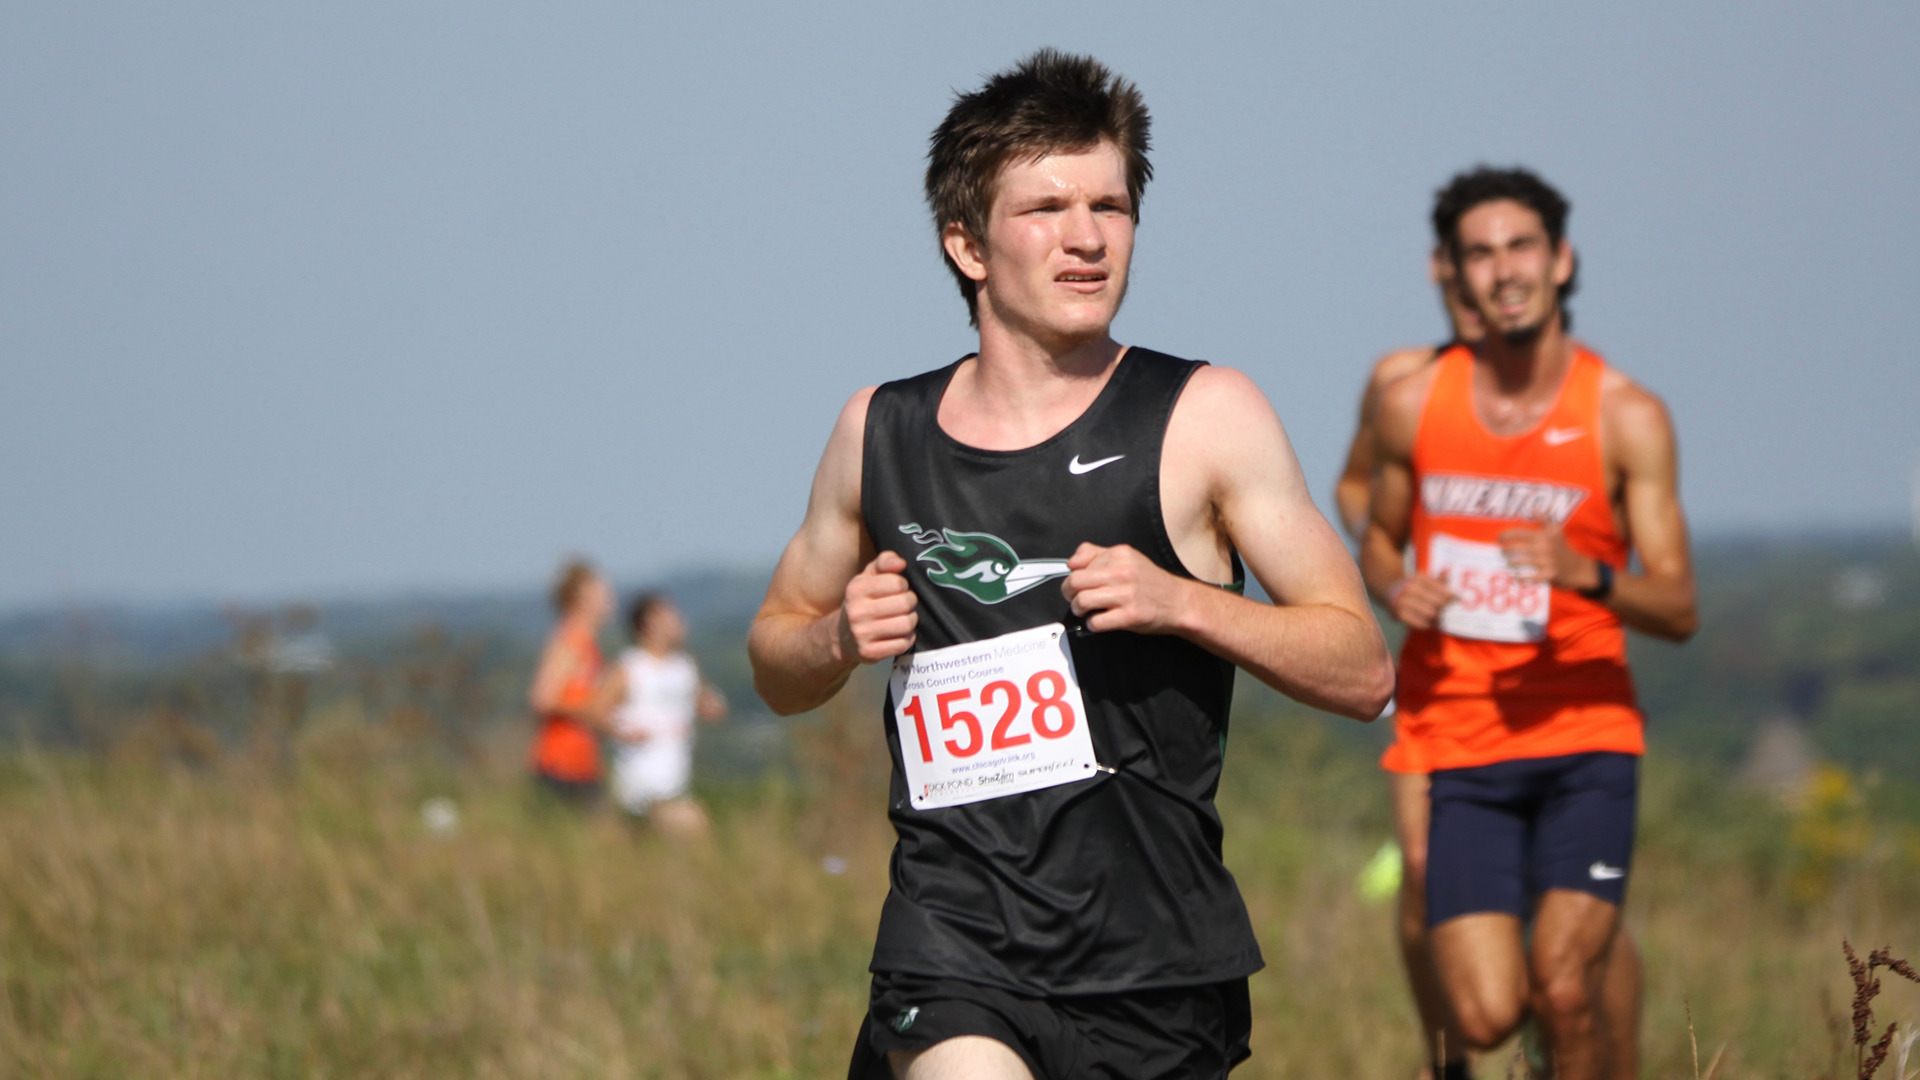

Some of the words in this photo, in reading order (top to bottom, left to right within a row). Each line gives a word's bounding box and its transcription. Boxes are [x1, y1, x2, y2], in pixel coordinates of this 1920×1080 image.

[911, 652, 992, 675] Northwestern
[993, 640, 1047, 659] Medicine
[926, 673, 967, 687] Country
[967, 665, 1005, 679] Course
[903, 669, 1076, 764] 1528
